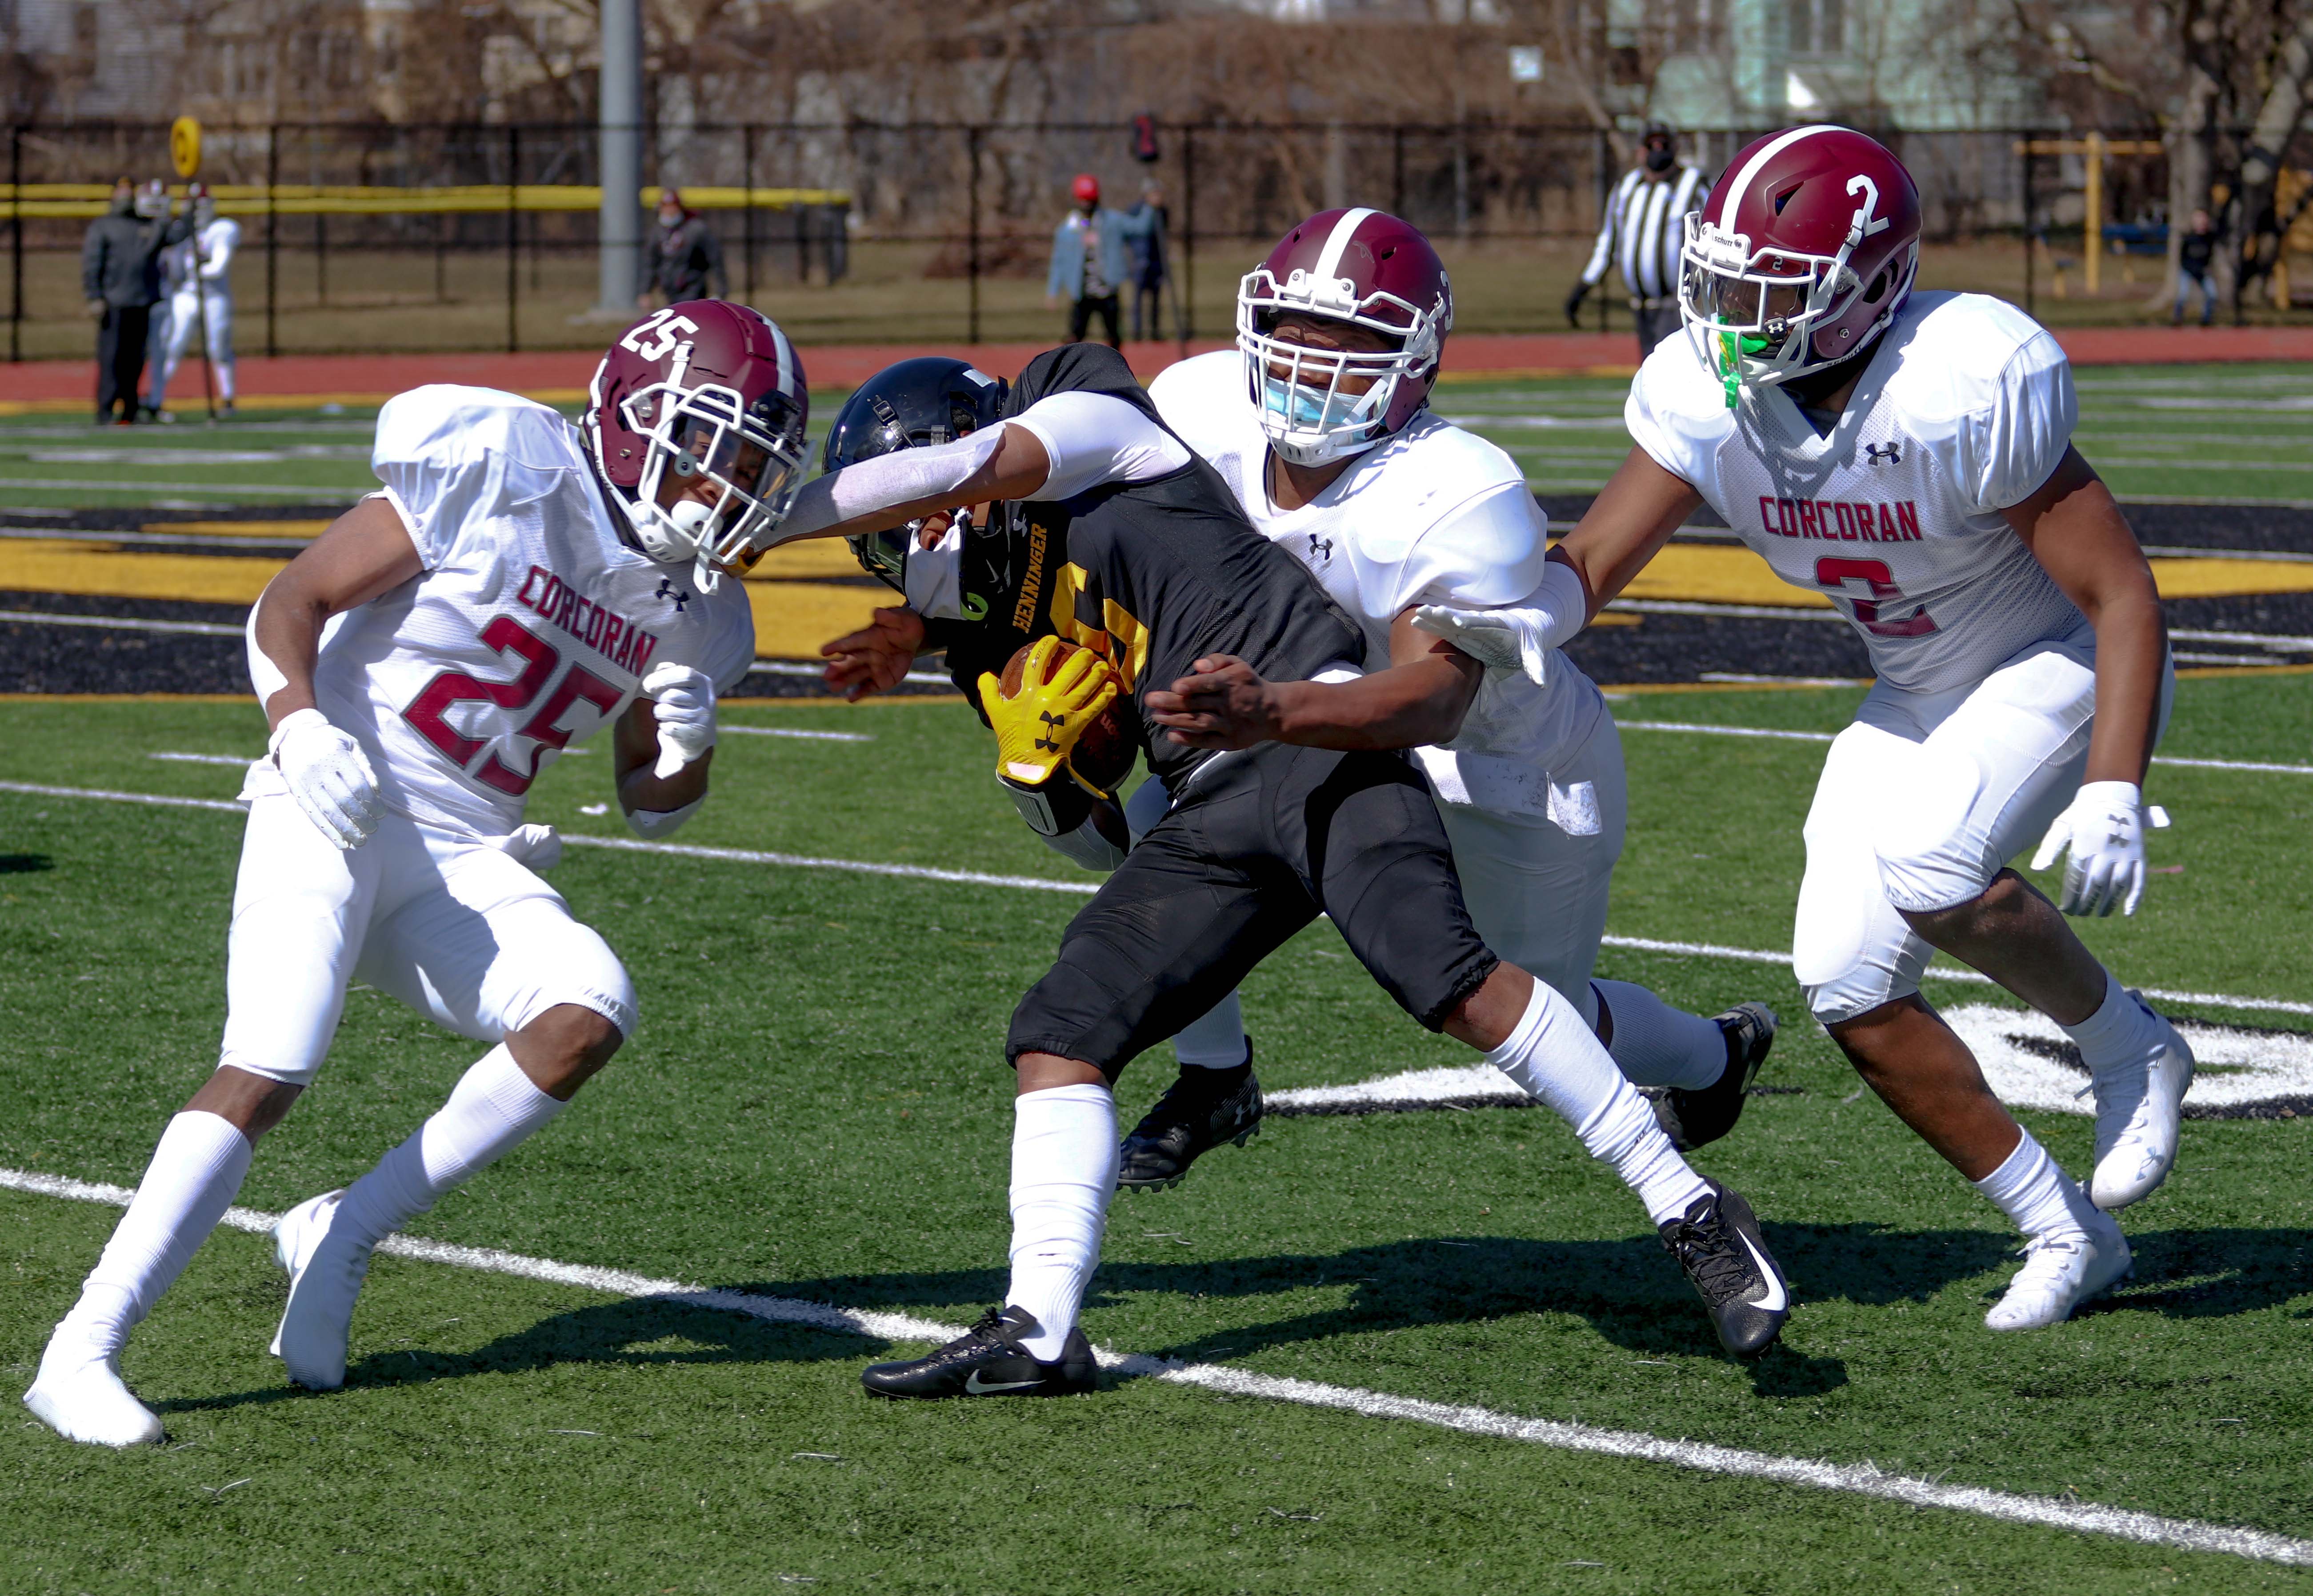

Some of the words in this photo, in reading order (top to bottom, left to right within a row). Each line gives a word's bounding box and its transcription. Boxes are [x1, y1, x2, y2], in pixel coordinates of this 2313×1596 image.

[1846, 174, 1889, 237] 2
[1714, 236, 1733, 247] schutt
[1772, 256, 1783, 271] 2
[620, 308, 699, 361] 25
[1759, 496, 1923, 543] CORCORAN
[1012, 523, 1047, 634] HENNINGER
[1814, 555, 1941, 639] 2
[516, 564, 659, 677] CORCORAN
[400, 613, 626, 797] 25
